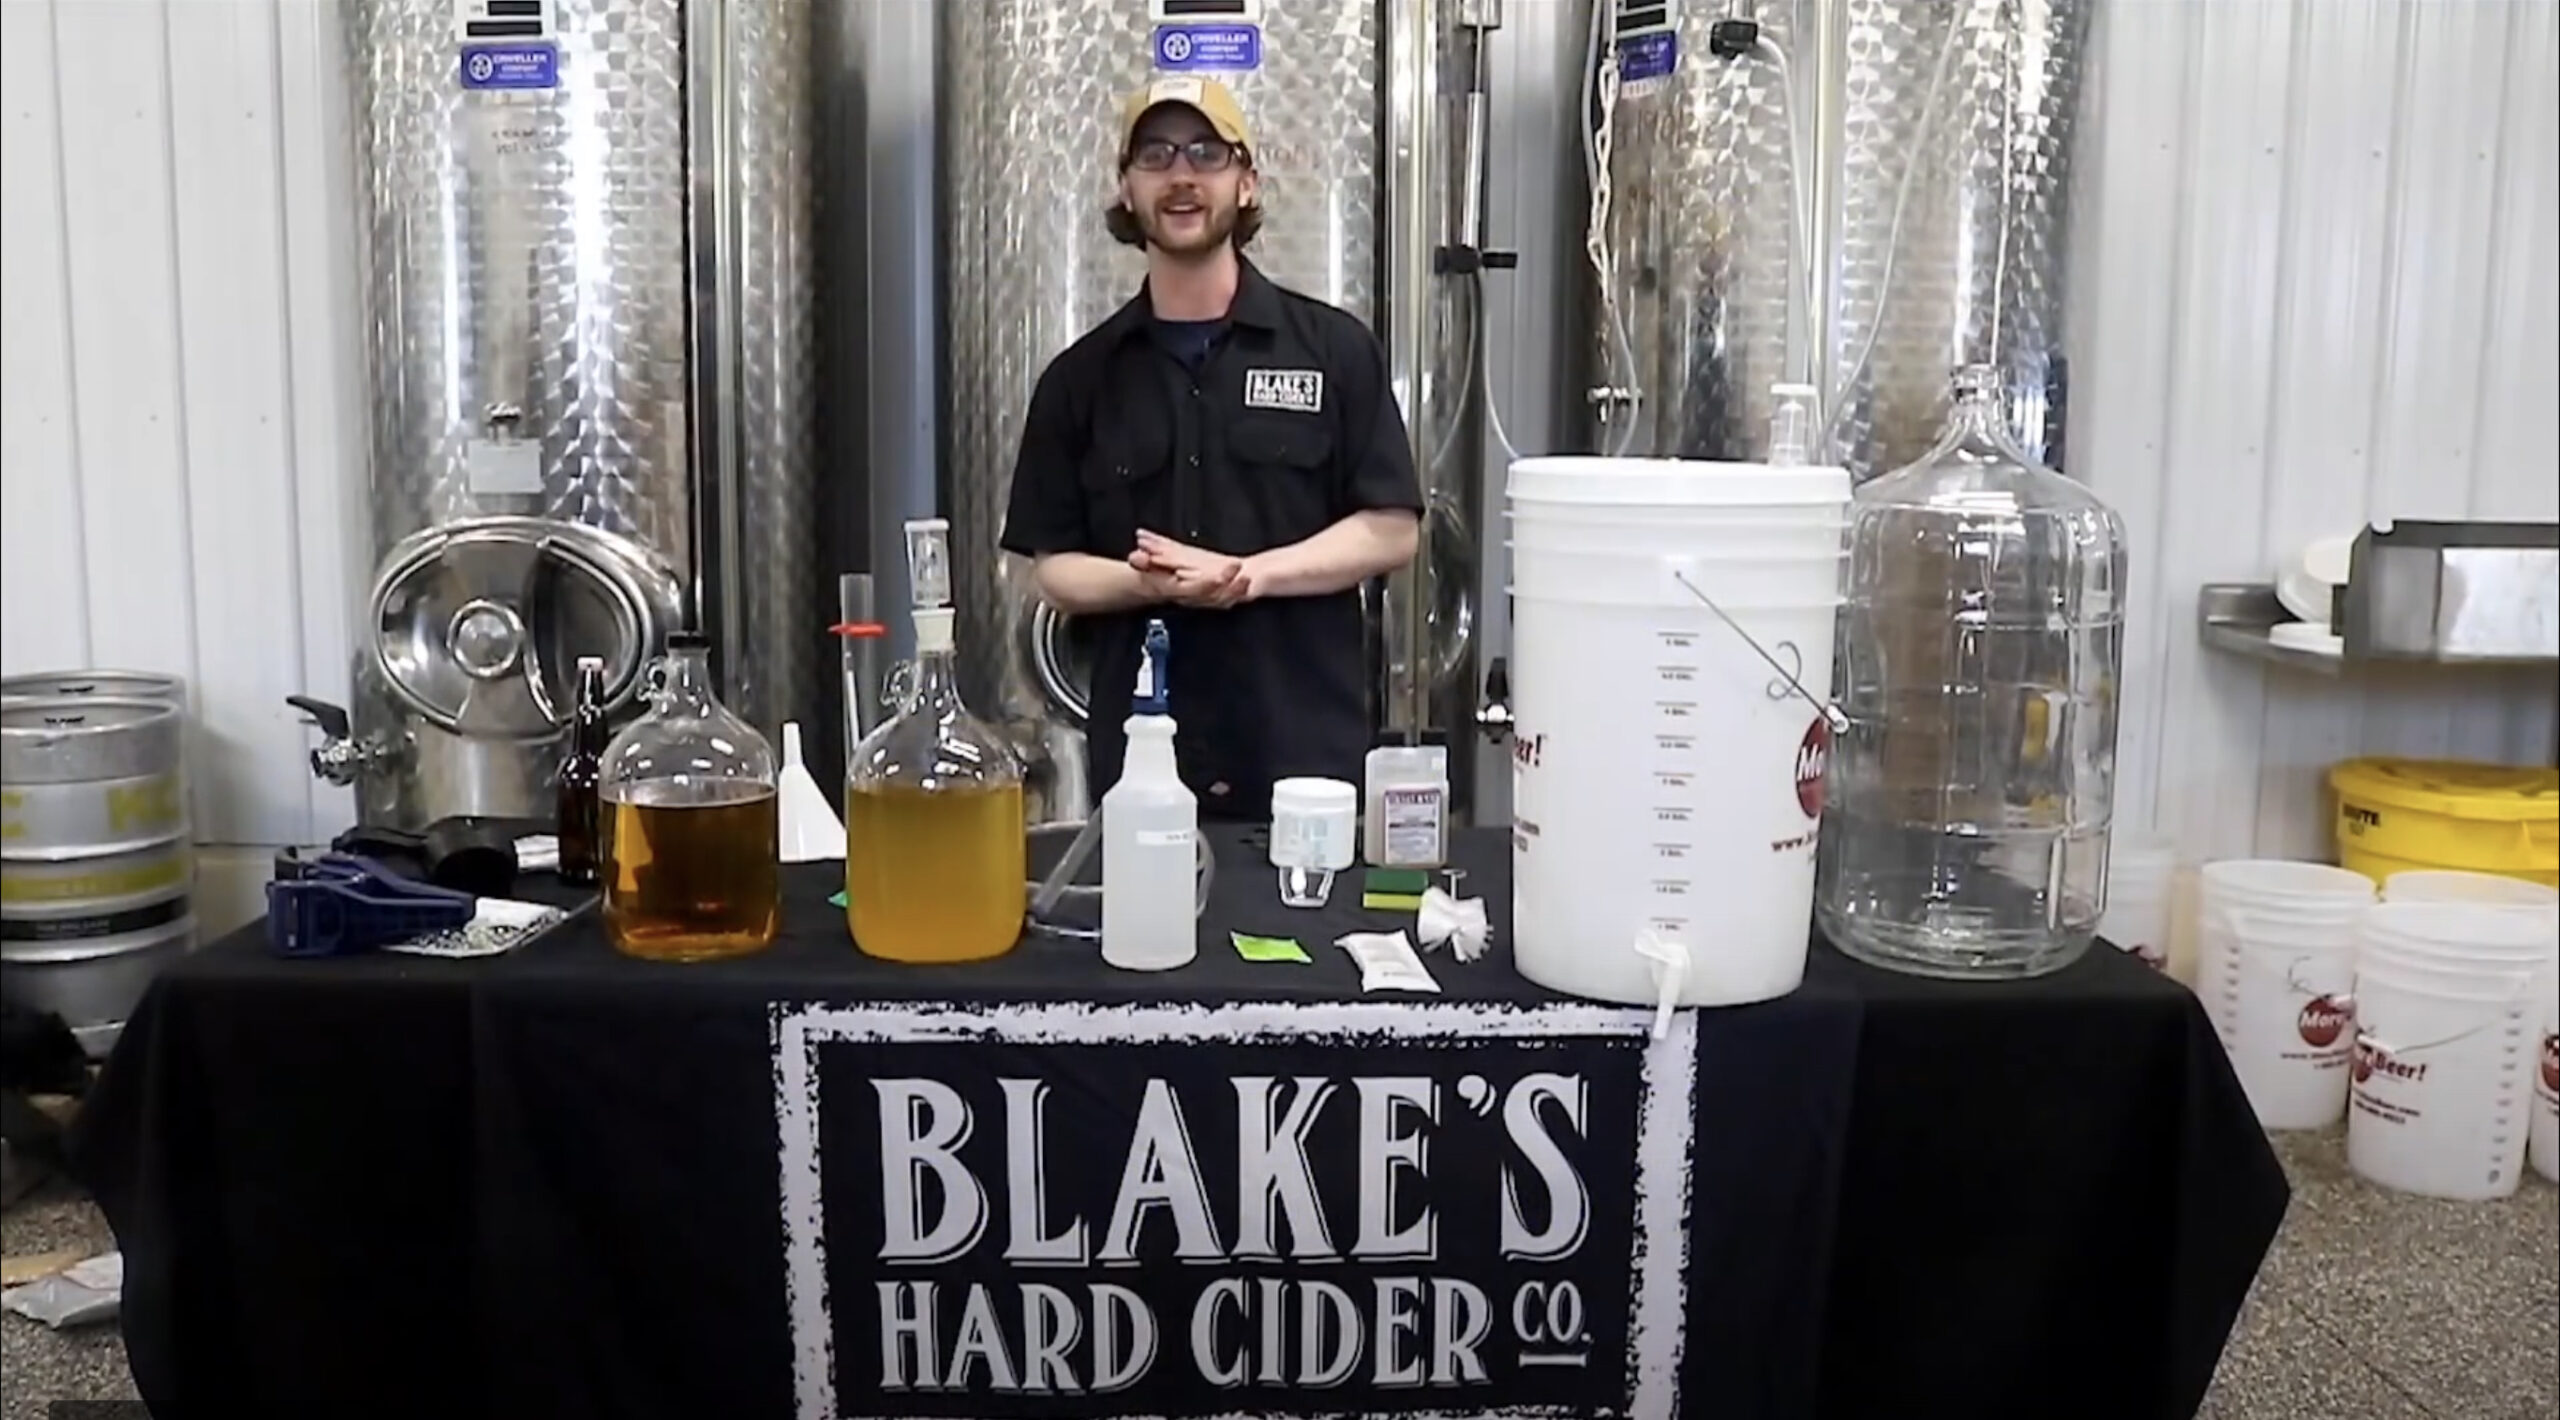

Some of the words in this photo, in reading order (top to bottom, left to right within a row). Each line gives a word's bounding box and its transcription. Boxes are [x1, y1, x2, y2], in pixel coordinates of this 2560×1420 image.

[870, 1072, 1591, 1268] BLAKE'S
[875, 1280, 1160, 1393] HARD
[1190, 1275, 1494, 1390] CIDER
[1512, 1280, 1594, 1345] CO.
